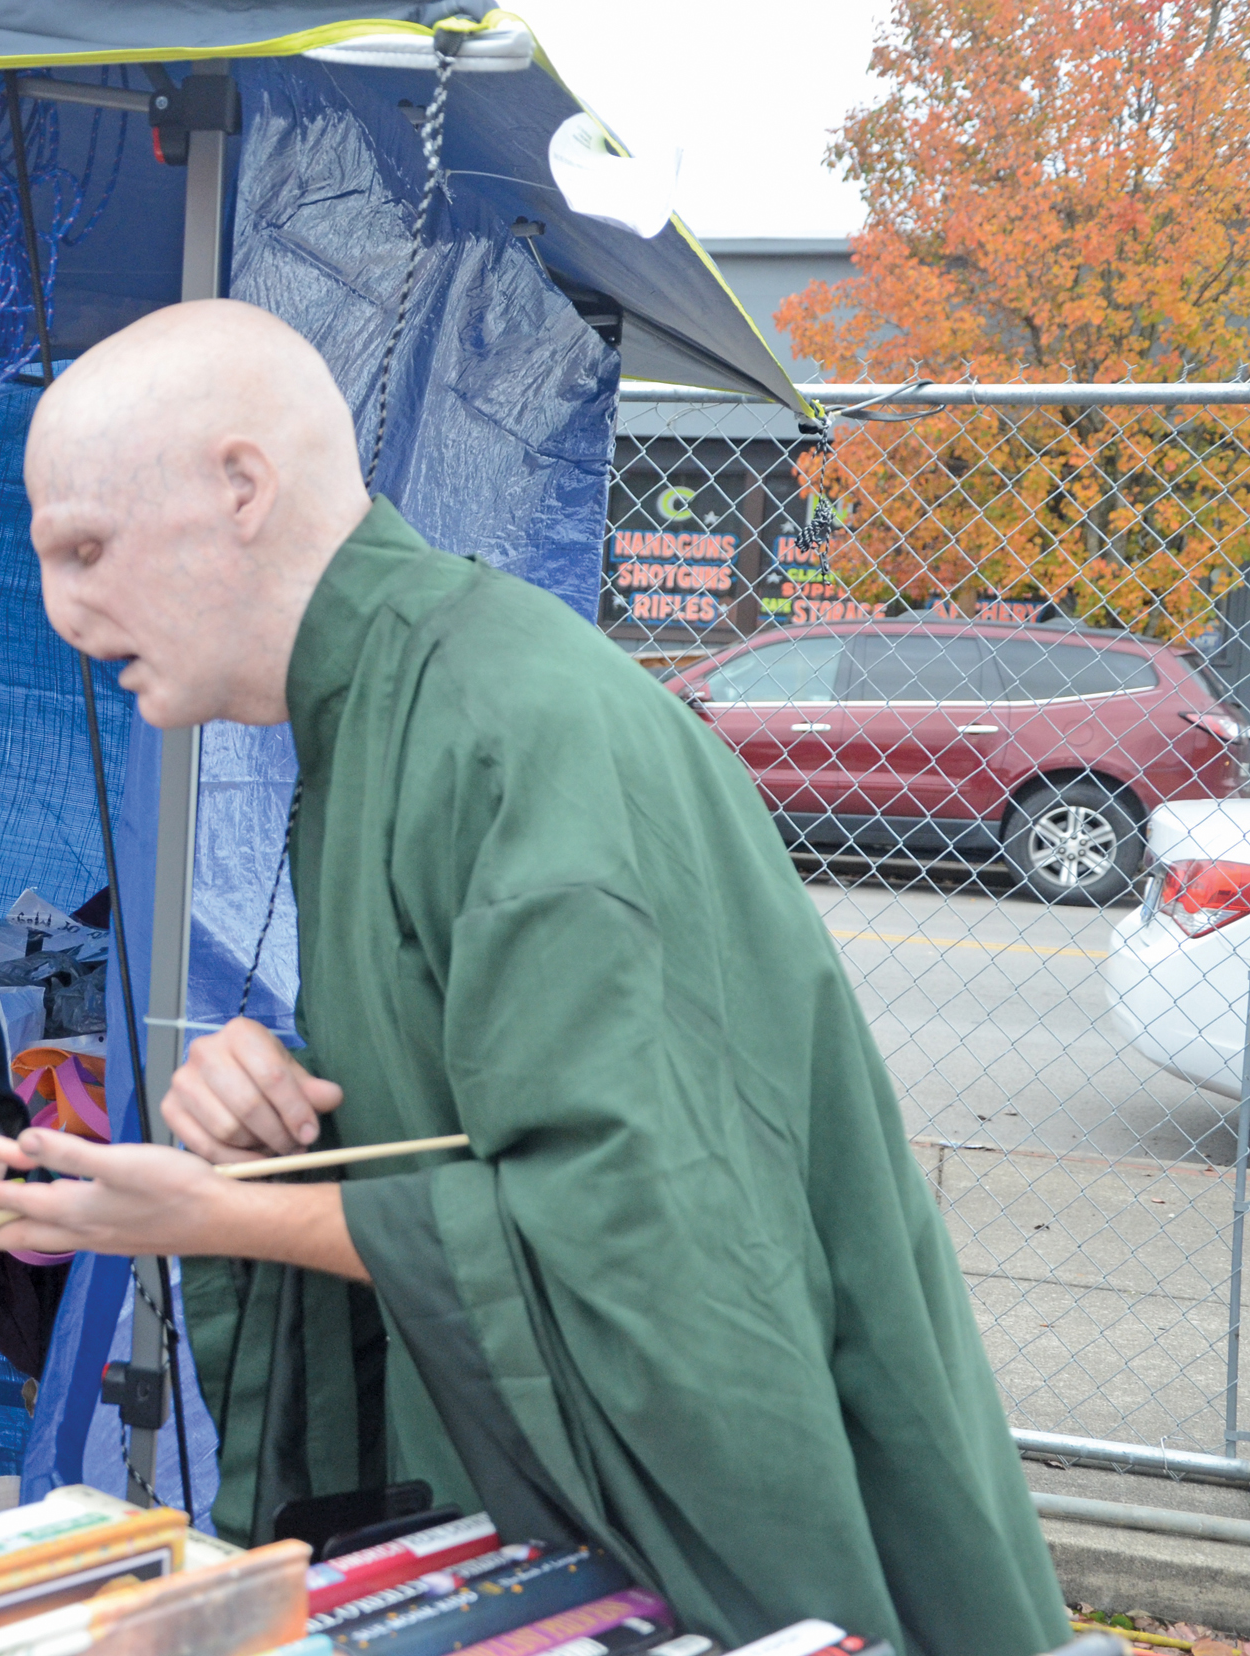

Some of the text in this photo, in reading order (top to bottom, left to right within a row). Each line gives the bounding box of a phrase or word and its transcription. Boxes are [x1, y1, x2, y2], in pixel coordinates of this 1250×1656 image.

[656, 486, 697, 521] C
[614, 531, 736, 560] HANDGUNS
[617, 562, 732, 590] SHOTGUNS
[633, 594, 715, 621] RIFLES
[792, 599, 887, 624] STORAGE
[932, 600, 1044, 624] AHERY
